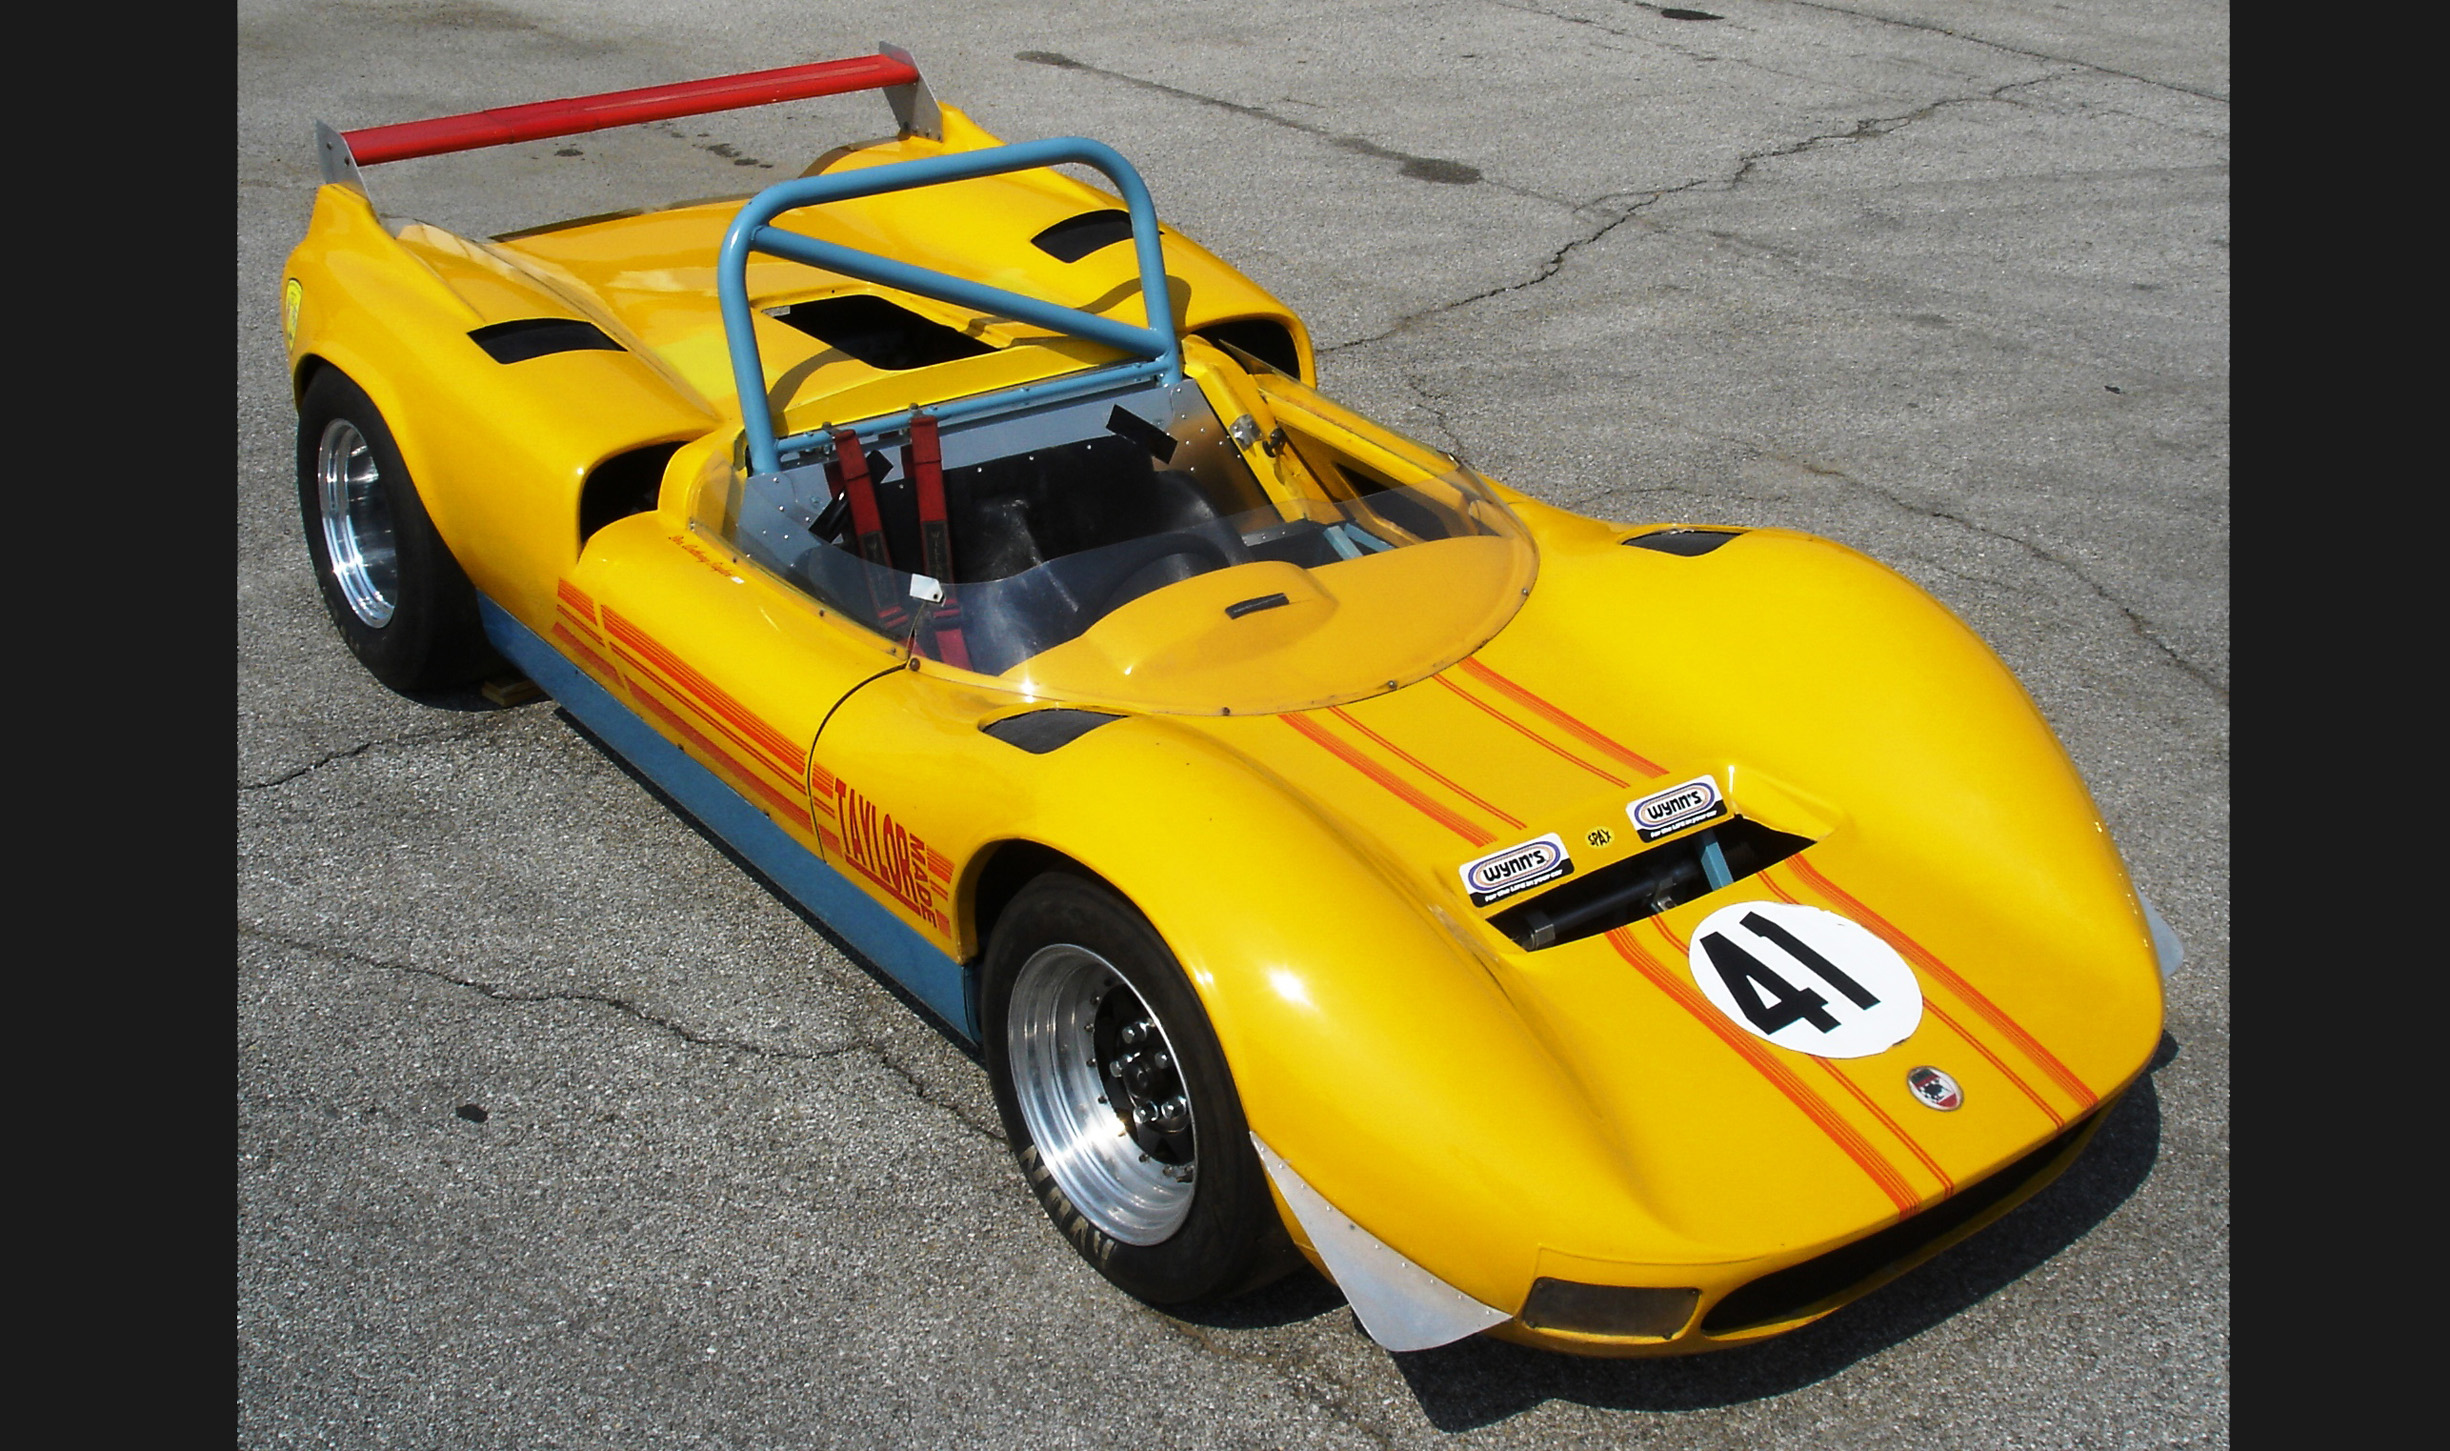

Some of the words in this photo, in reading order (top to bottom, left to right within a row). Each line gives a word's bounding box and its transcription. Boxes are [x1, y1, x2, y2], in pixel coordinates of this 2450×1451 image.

[835, 777, 919, 903] TAYLOR
[910, 832, 937, 928] MADE
[1587, 828, 1612, 847] SPAX
[1700, 911, 1881, 1035] 41
